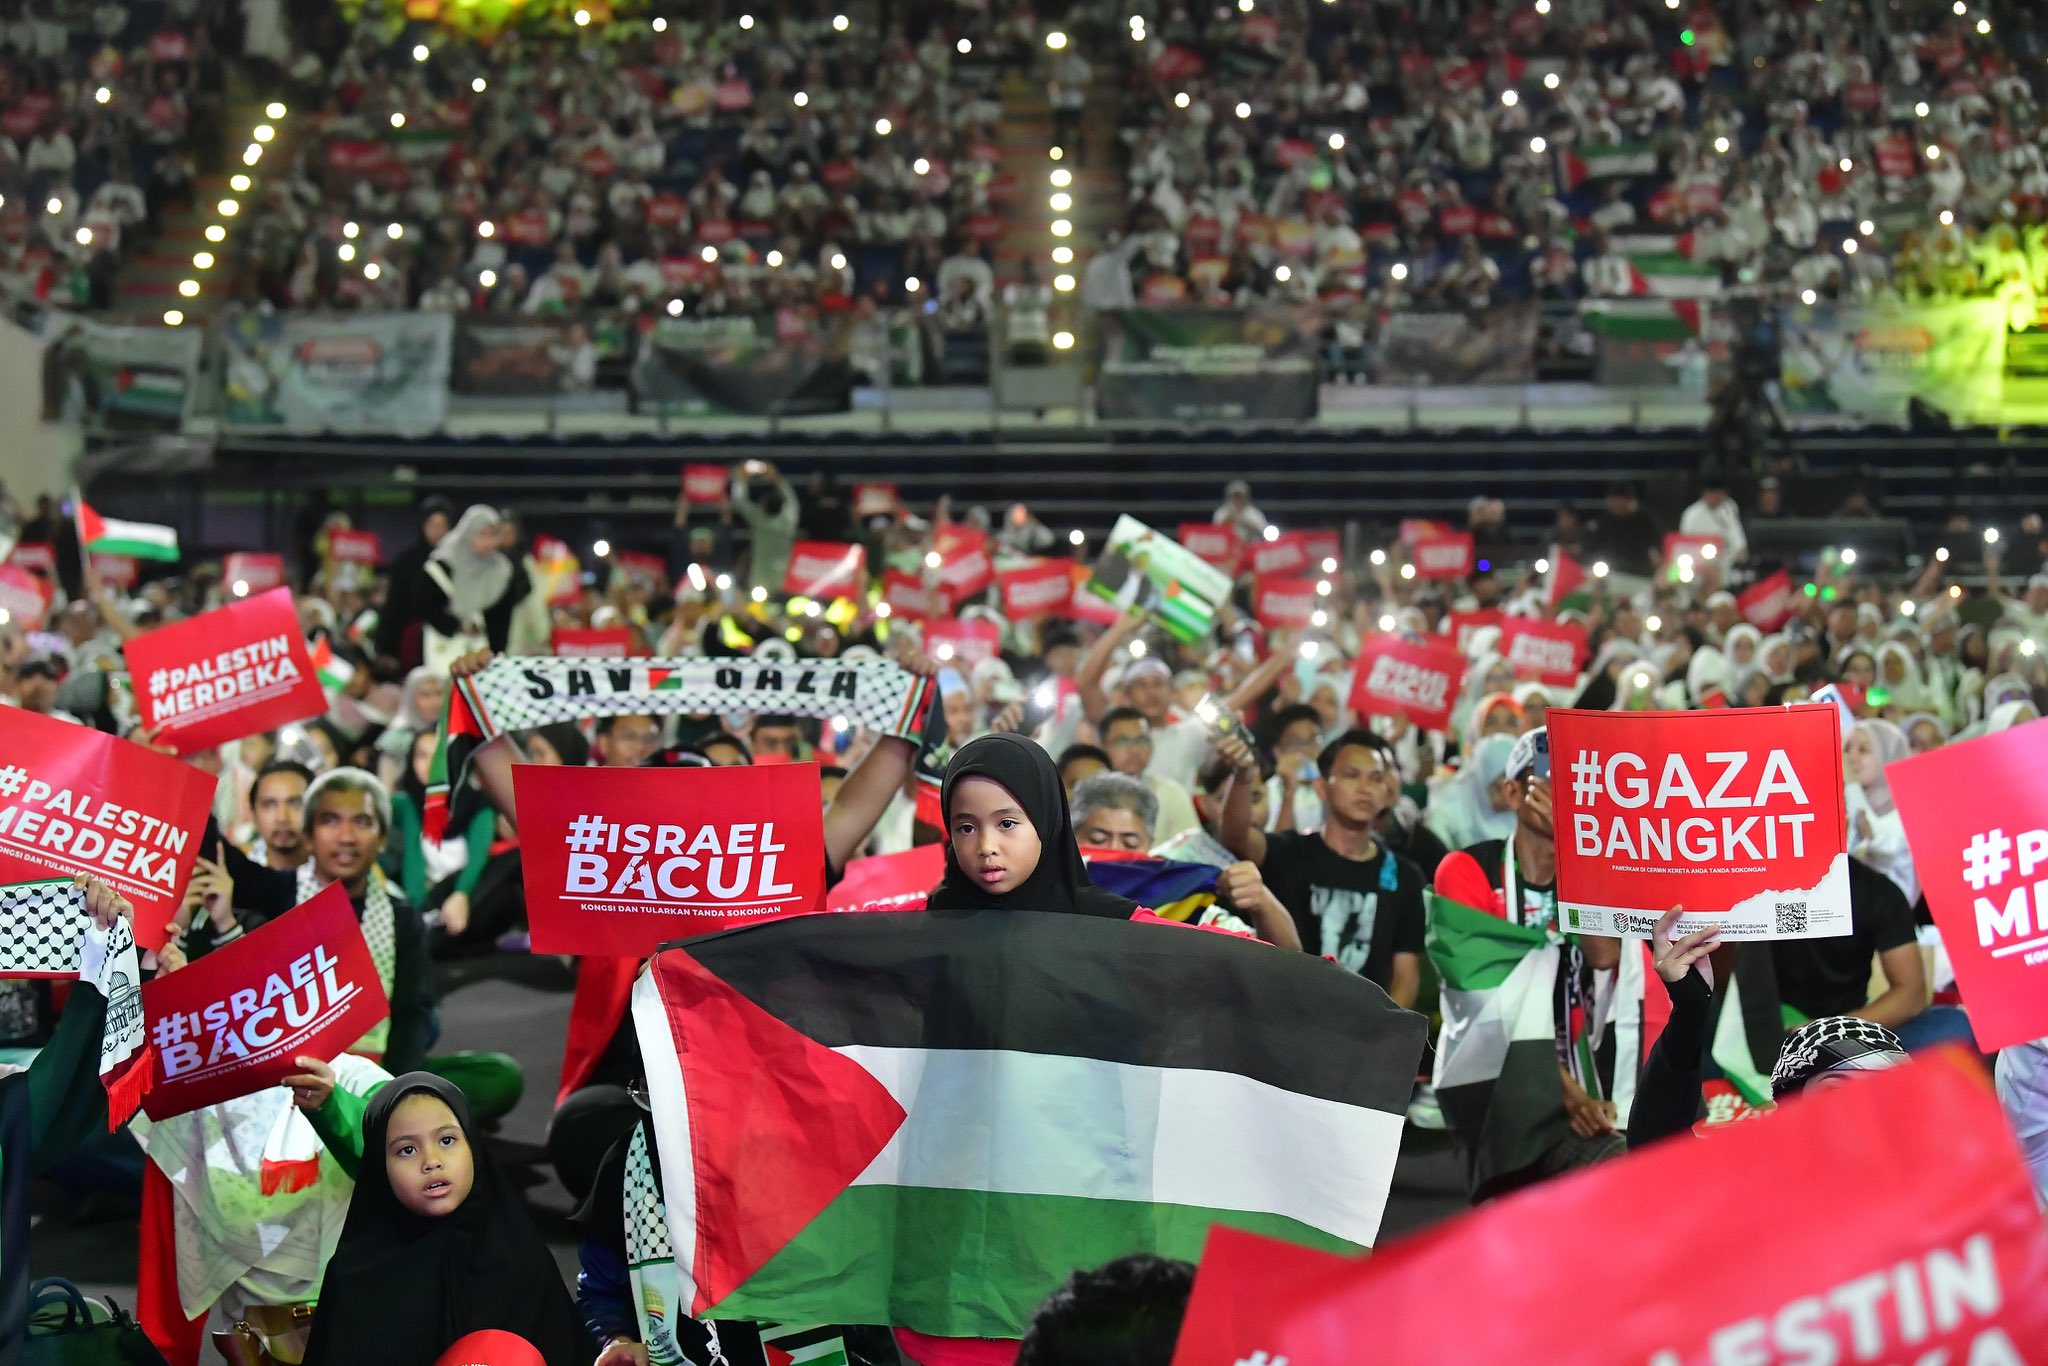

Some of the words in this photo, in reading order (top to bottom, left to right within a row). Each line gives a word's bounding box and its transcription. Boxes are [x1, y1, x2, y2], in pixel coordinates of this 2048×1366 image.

[149, 634, 290, 697] #PALESTIN
[153, 656, 300, 722] MERDEKA
[1570, 749, 1810, 809] #GAZA
[0, 765, 189, 854] #PALESTIN
[565, 814, 786, 855] #ISRAEL
[1573, 812, 1815, 862] BANGKIT
[24, 854, 43, 866] DAN
[44, 860, 83, 876] TULARKA
[118, 883, 159, 902] SOKONGAN
[565, 853, 794, 900] BACUL
[580, 903, 616, 912] KONGSI
[618, 905, 639, 913] DAN
[640, 906, 691, 916] TULARKAN
[692, 909, 725, 917] TANDA
[726, 905, 781, 917] SOKONGAN
[1629, 916, 1659, 927] MyAqs
[152, 944, 338, 1048] #ISRAEL
[160, 967, 354, 1077] BACUL
[283, 1034, 310, 1053] TANDA
[310, 1003, 351, 1037] SOKONGAN
